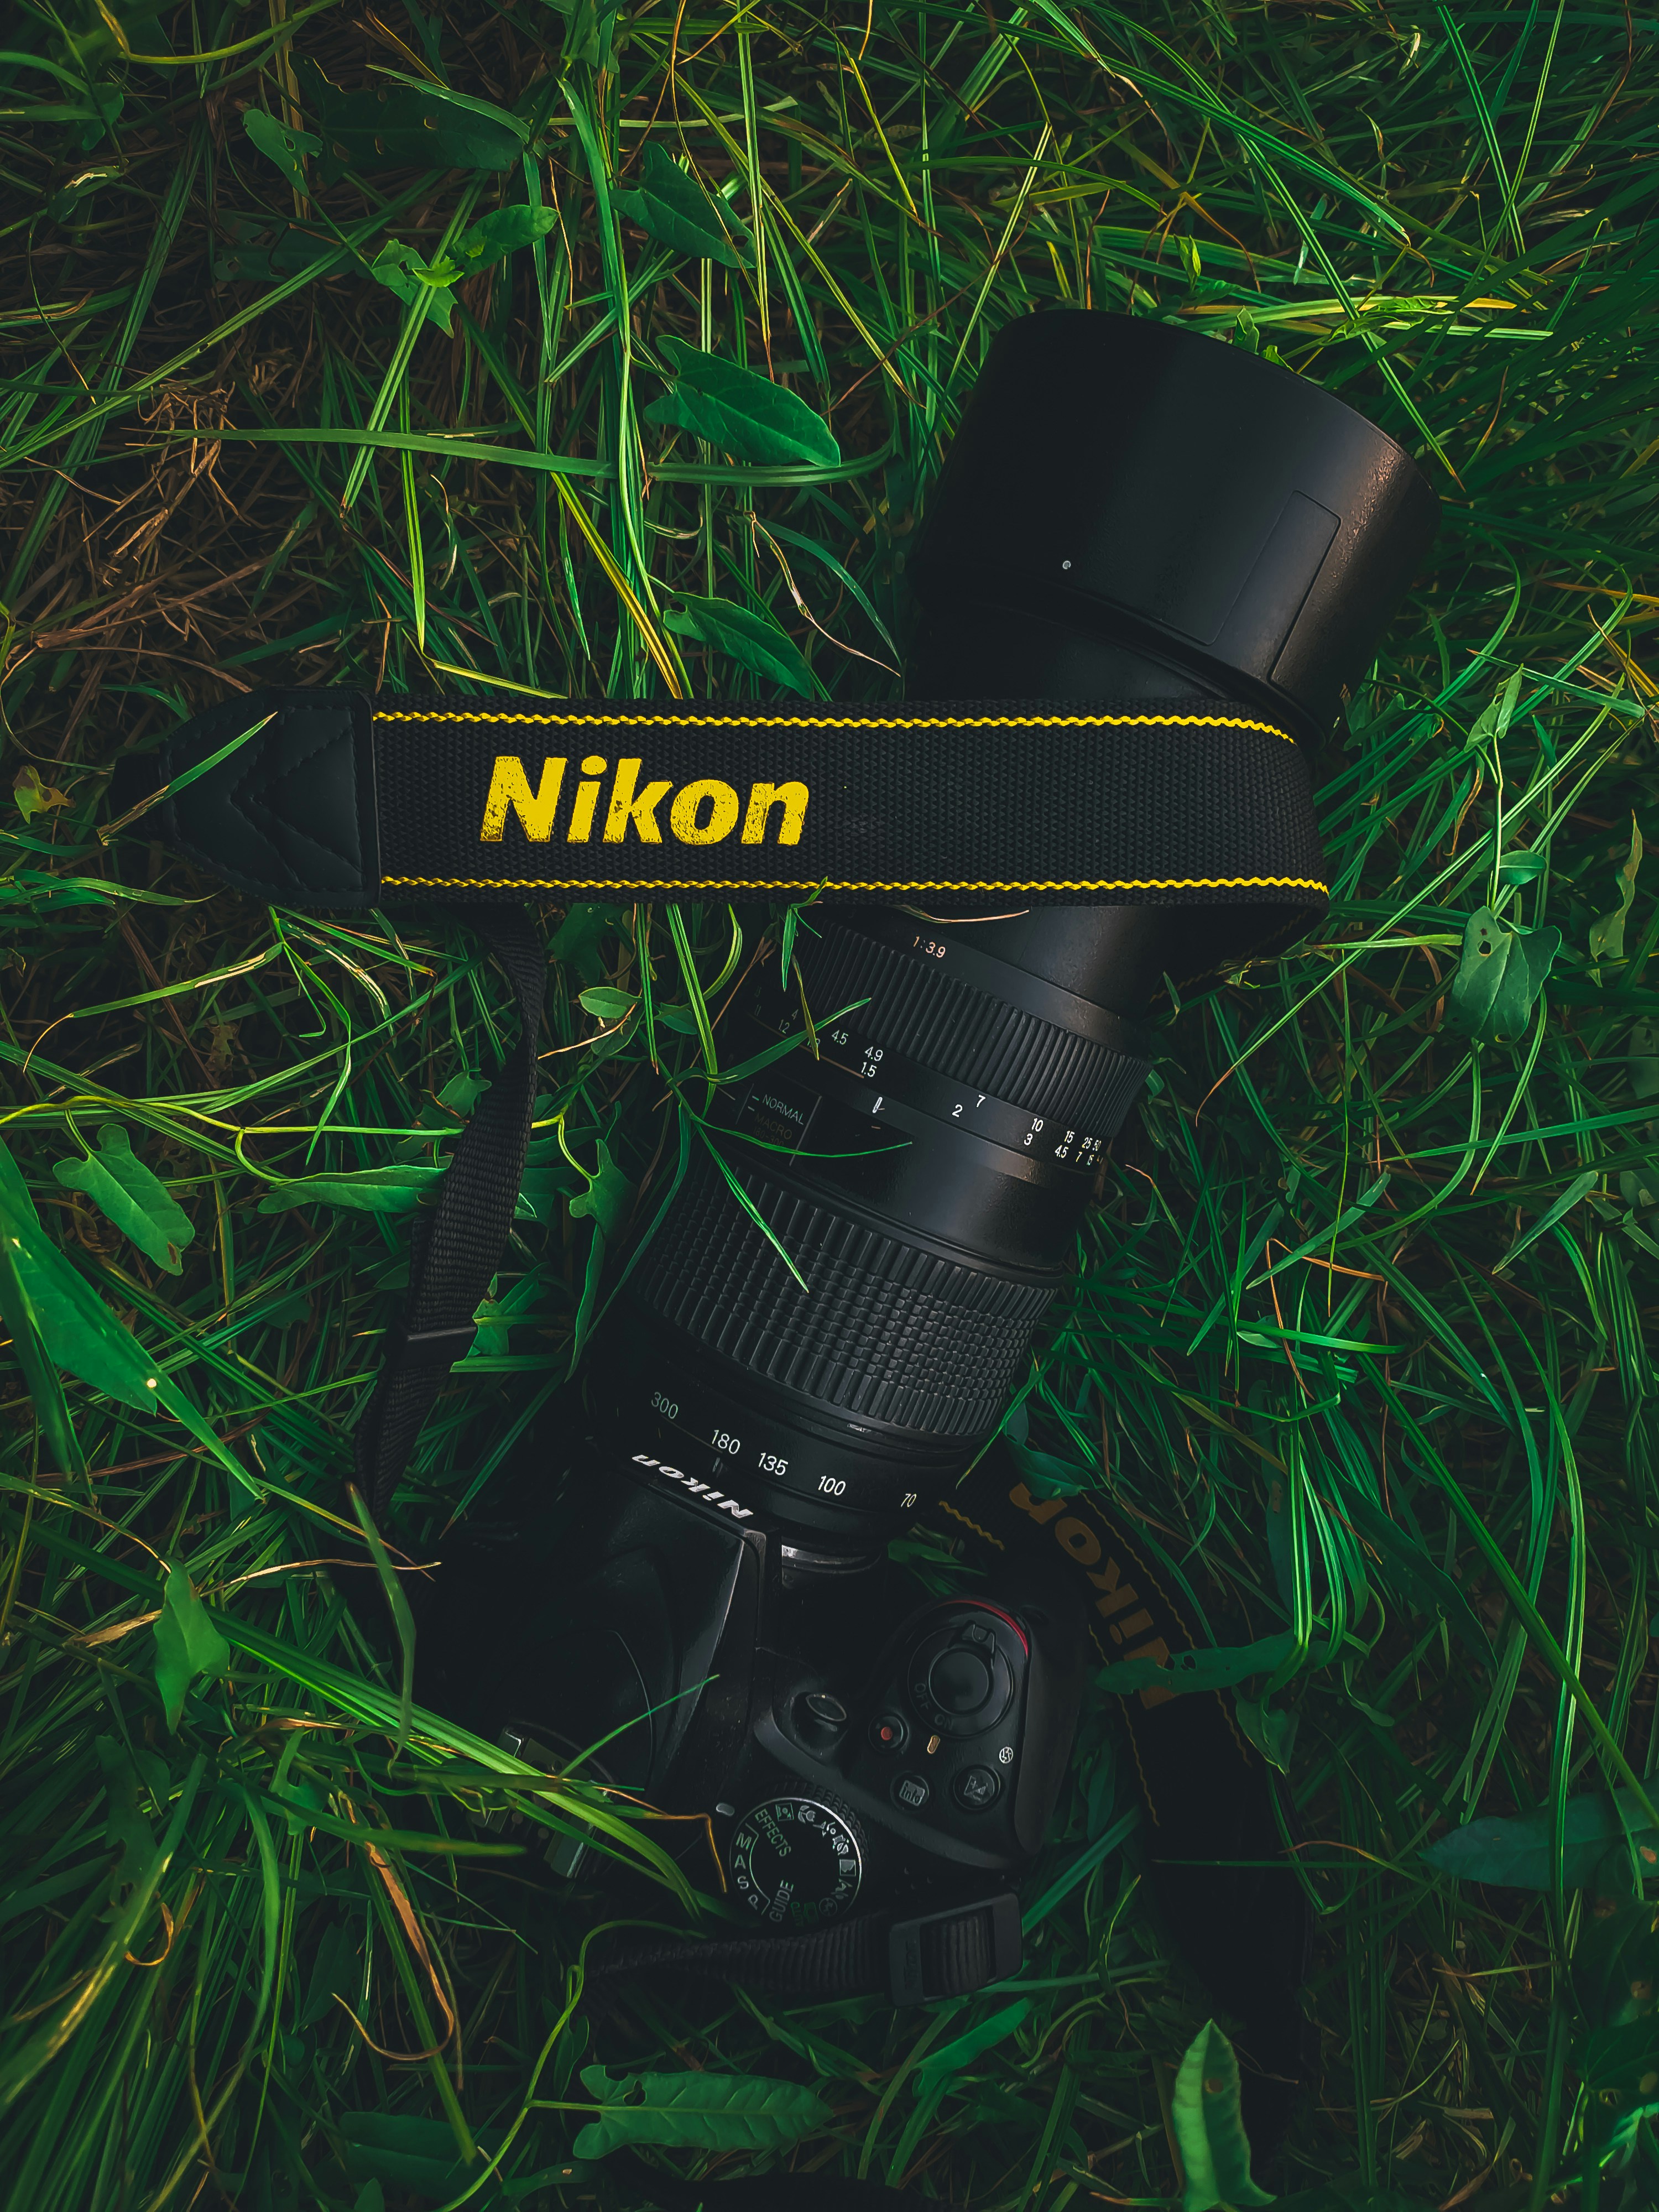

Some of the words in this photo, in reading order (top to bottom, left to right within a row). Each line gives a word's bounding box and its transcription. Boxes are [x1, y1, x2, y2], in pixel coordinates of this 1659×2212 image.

[479, 755, 809, 846] Nikon
[912, 936, 946, 959] 1:3.9
[778, 1019, 790, 1034] 1.2
[861, 1062, 877, 1078] 1.5
[952, 1104, 963, 1118] 2
[1024, 1133, 1033, 1146] 3
[1055, 1144, 1069, 1159] 4.5
[1076, 1151, 1083, 1162] 7
[791, 1009, 799, 1020] 4
[831, 1029, 849, 1045] 4.5
[864, 1046, 883, 1062] 4.9
[975, 1094, 986, 1108] 7
[1031, 1118, 1044, 1132] 10
[1064, 1130, 1075, 1144] 15
[1082, 1136, 1093, 1149] 25
[762, 1094, 804, 1125] NORMAL
[754, 1113, 792, 1140] MACRO
[651, 1391, 679, 1420] 300
[711, 1429, 741, 1455] 180
[758, 1452, 789, 1477] 135
[817, 1475, 846, 1496] 100
[900, 1493, 917, 1508] 70
[632, 1454, 753, 1519] Nikon
[914, 1682, 932, 1710] OFF
[935, 1714, 954, 1730] ON
[735, 1832, 752, 1850] M
[755, 1808, 791, 1857] EFFECTS
[734, 1854, 747, 1870] A
[737, 1876, 749, 1890] S
[748, 1894, 759, 1910] P
[769, 1879, 795, 1923] GUIDE
